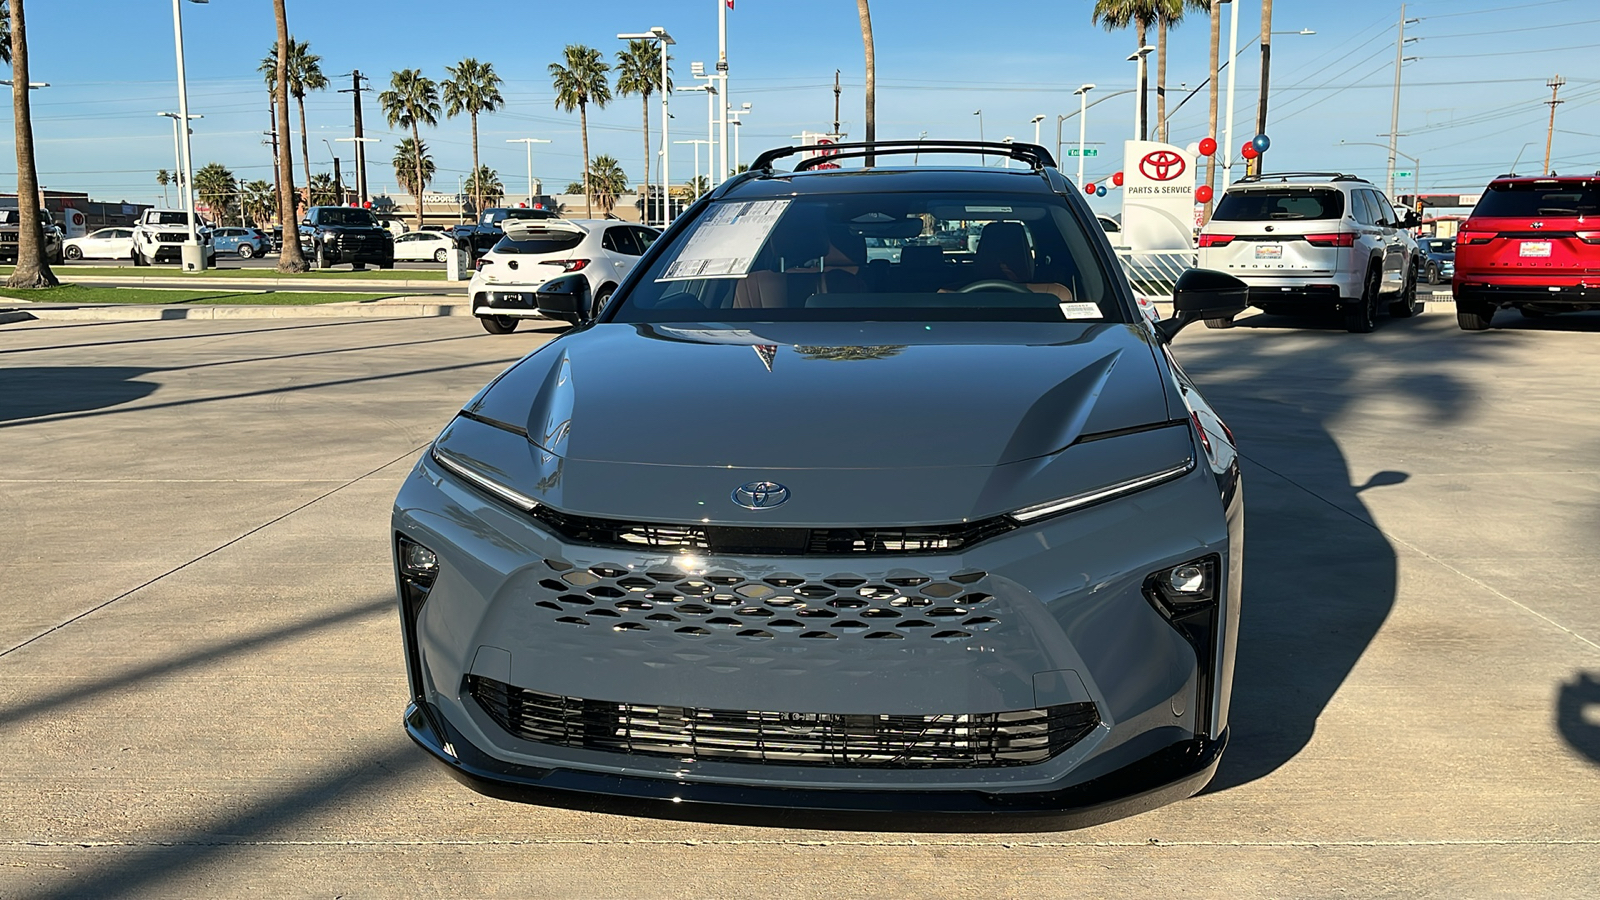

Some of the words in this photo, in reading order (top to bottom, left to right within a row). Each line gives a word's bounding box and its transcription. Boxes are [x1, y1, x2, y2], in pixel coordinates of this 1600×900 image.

[1128, 186, 1153, 194] PARTS
[1153, 186, 1160, 194] &
[1161, 186, 1192, 194] SERVICE
